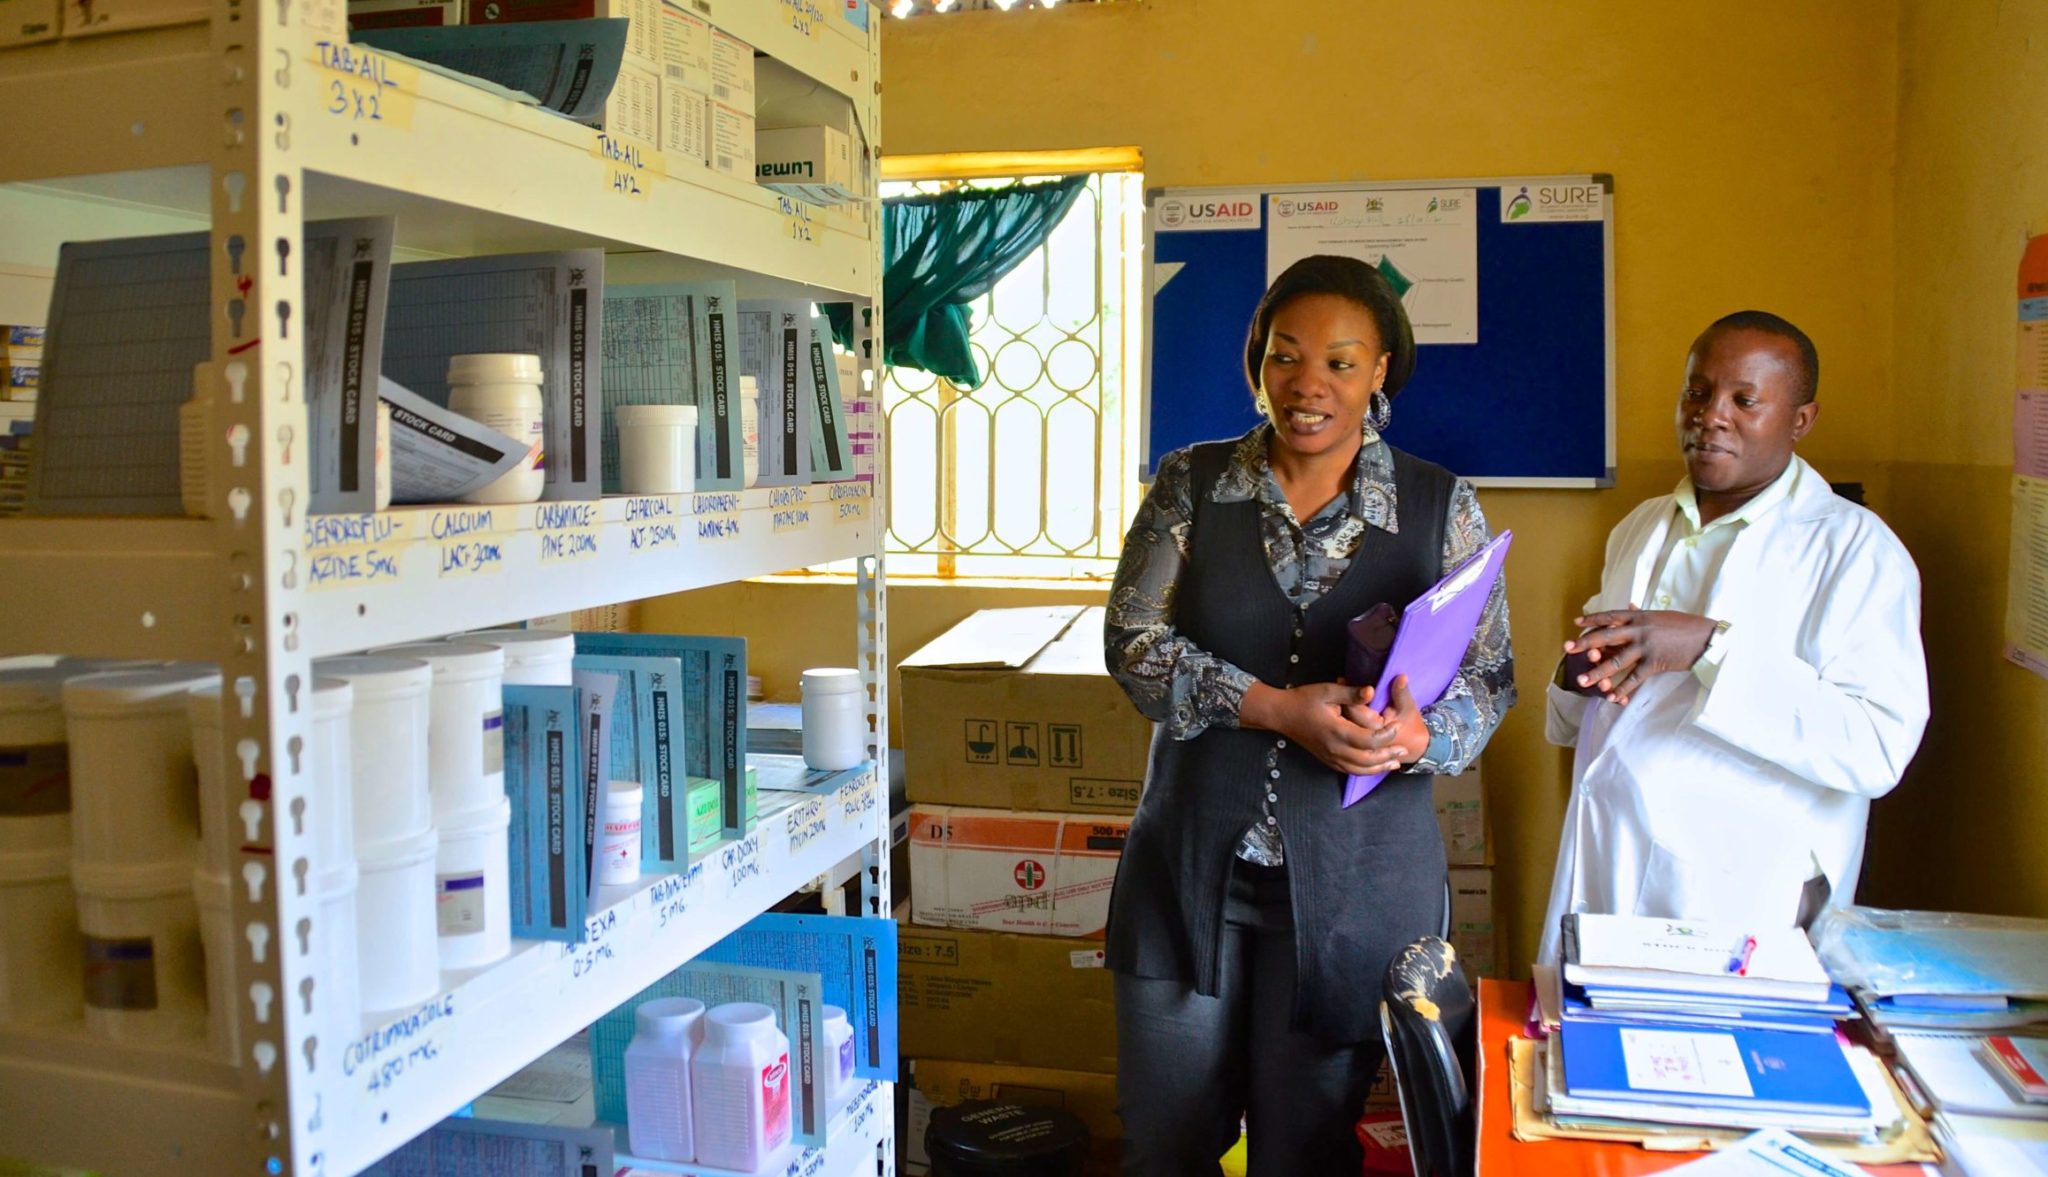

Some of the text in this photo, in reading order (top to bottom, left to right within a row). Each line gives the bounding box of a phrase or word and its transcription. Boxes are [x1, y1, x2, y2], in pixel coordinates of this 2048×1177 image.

[1297, 201, 1338, 211] USAID
[1539, 186, 1599, 204] SURE
[1189, 202, 1253, 218] USAID
[353, 280, 367, 310] HMIS
[574, 305, 584, 331] HMIS
[574, 333, 583, 352] 015
[713, 320, 722, 342] HMIS
[348, 343, 361, 386] STOCK
[813, 347, 822, 366] HMIS
[574, 361, 583, 396] STOCK
[716, 366, 725, 392] STOCK
[345, 389, 357, 424] CARD
[717, 394, 726, 416] CARD
[819, 383, 828, 406] STOCK
[573, 398, 583, 427] CARD
[822, 405, 832, 424] CARD
[394, 409, 457, 442] STOCK CARD
[626, 497, 672, 522] CHARCOAL
[431, 510, 494, 540] CALCIUM
[727, 676, 736, 698] HMIS
[656, 697, 665, 720] HMIS
[727, 720, 736, 747] STOCK
[551, 738, 560, 765] HMIS
[659, 744, 668, 773] STOCK
[727, 748, 735, 769] CARD
[660, 773, 669, 797] CARD
[1074, 784, 1095, 798] 7.5
[1108, 787, 1139, 800] Size
[551, 793, 560, 825] STOCK
[588, 782, 596, 815] STOCK
[552, 827, 561, 855] CARD
[586, 817, 594, 845] CARD
[1093, 826, 1113, 835] 500
[934, 945, 955, 957] 7.5
